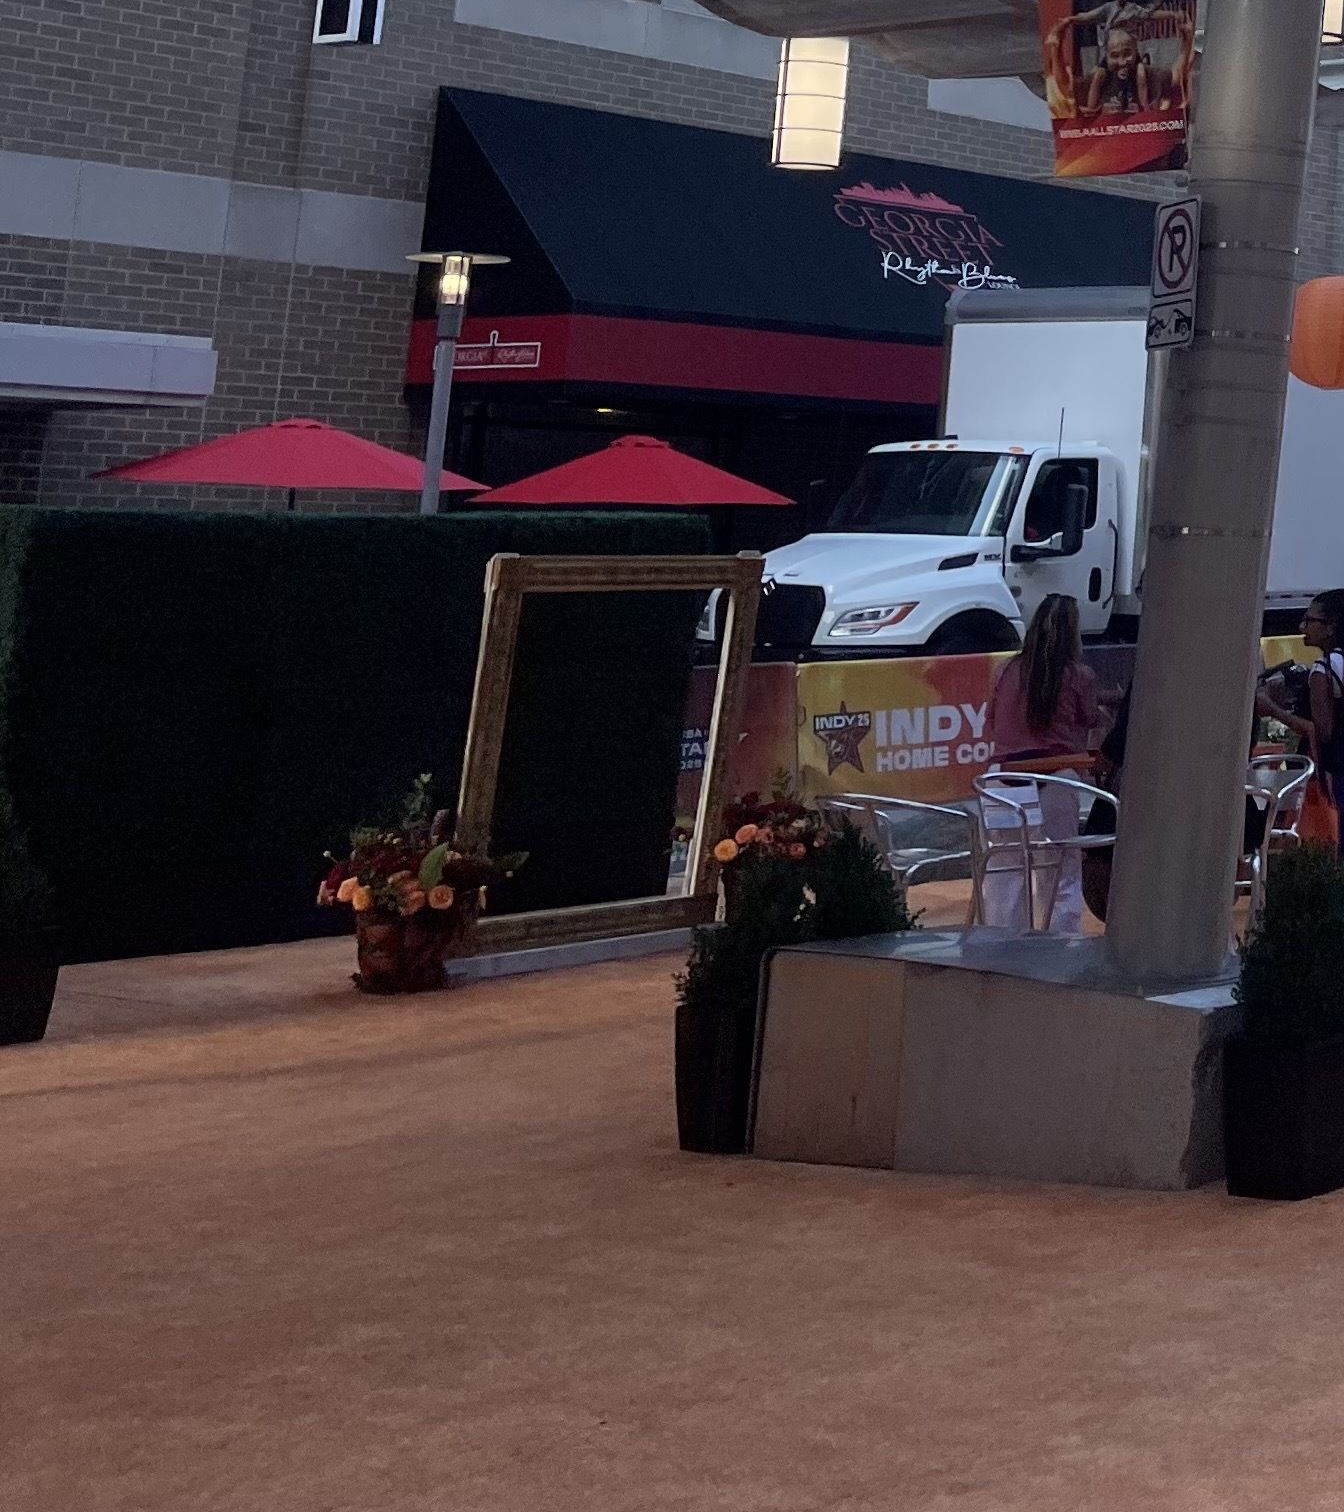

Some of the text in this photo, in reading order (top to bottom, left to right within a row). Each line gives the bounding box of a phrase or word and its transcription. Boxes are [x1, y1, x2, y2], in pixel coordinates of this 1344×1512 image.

[834, 202, 1004, 247] GEORGIA
[870, 229, 994, 266] STREET
[815, 715, 855, 730] INDY
[874, 701, 987, 748] INDY
[875, 745, 949, 773] HOME
